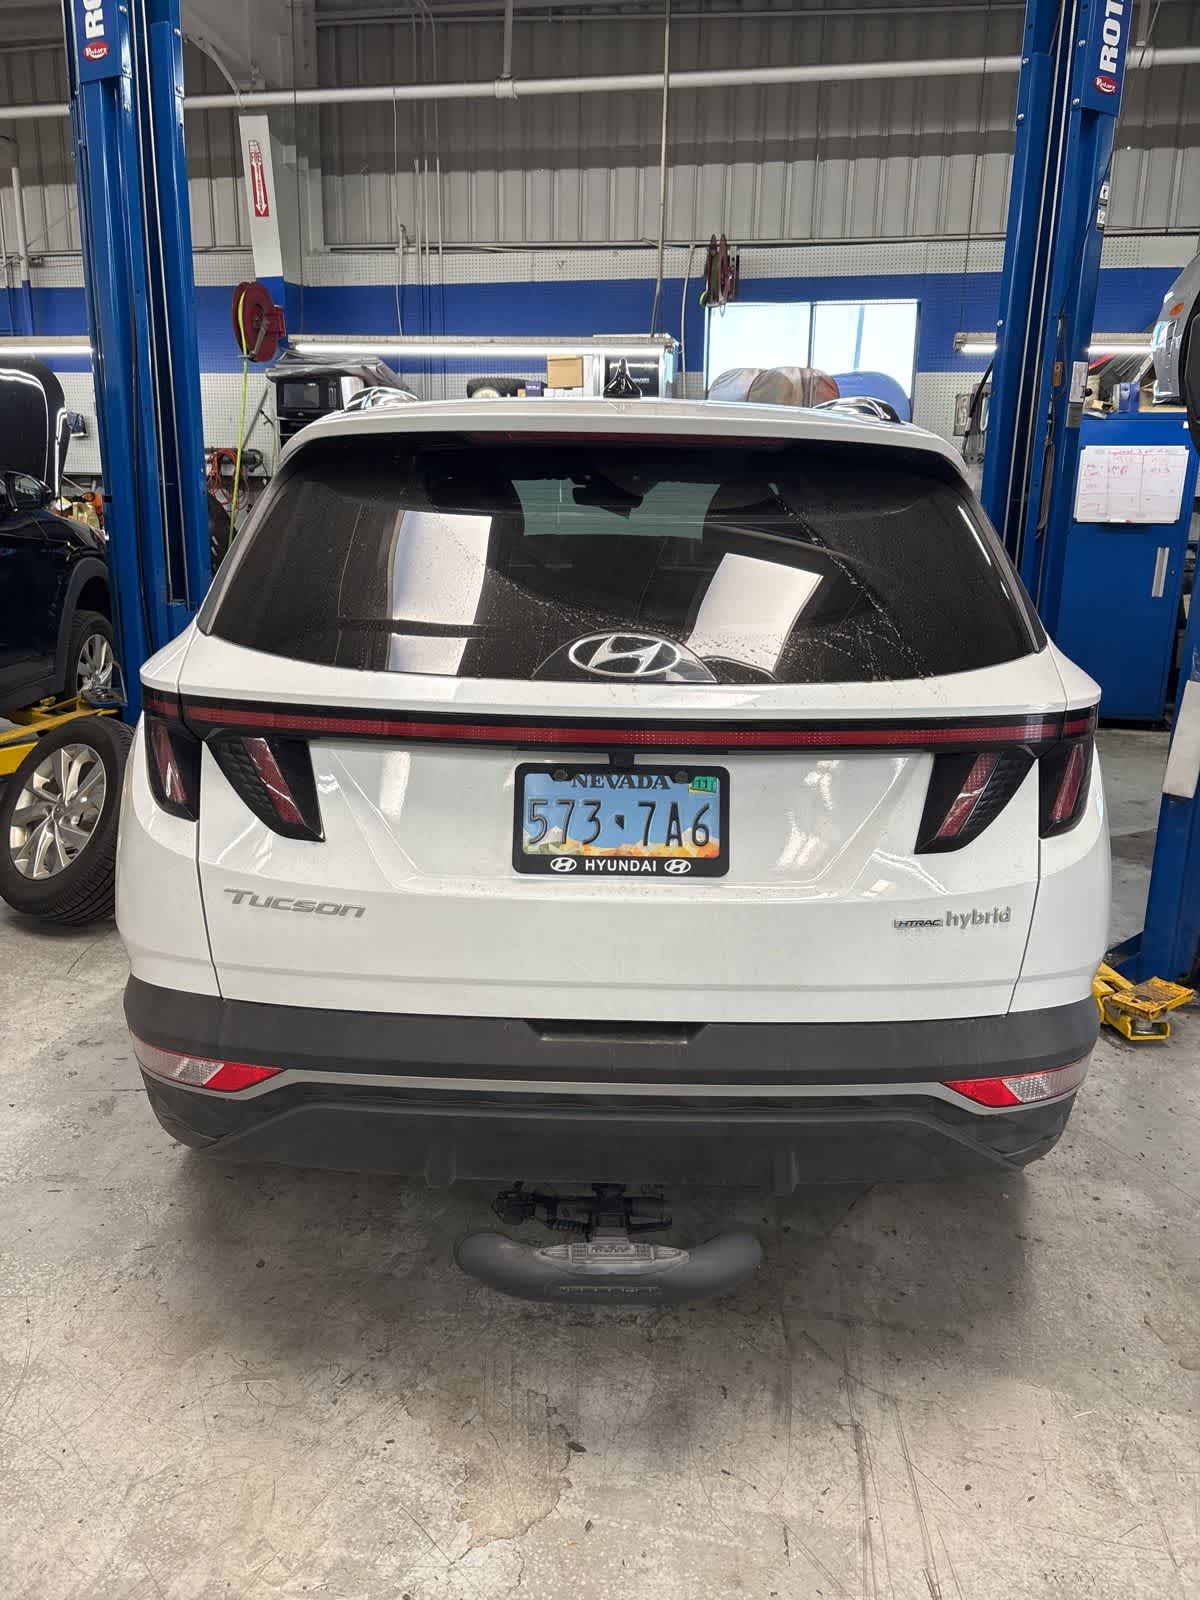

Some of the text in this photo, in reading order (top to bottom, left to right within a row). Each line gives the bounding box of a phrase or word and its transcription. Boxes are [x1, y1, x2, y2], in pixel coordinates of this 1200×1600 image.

[571, 774, 670, 790] NEVADA
[585, 859, 657, 872] HYUNDAI
[898, 905, 1011, 930] HTRAC hybrid
